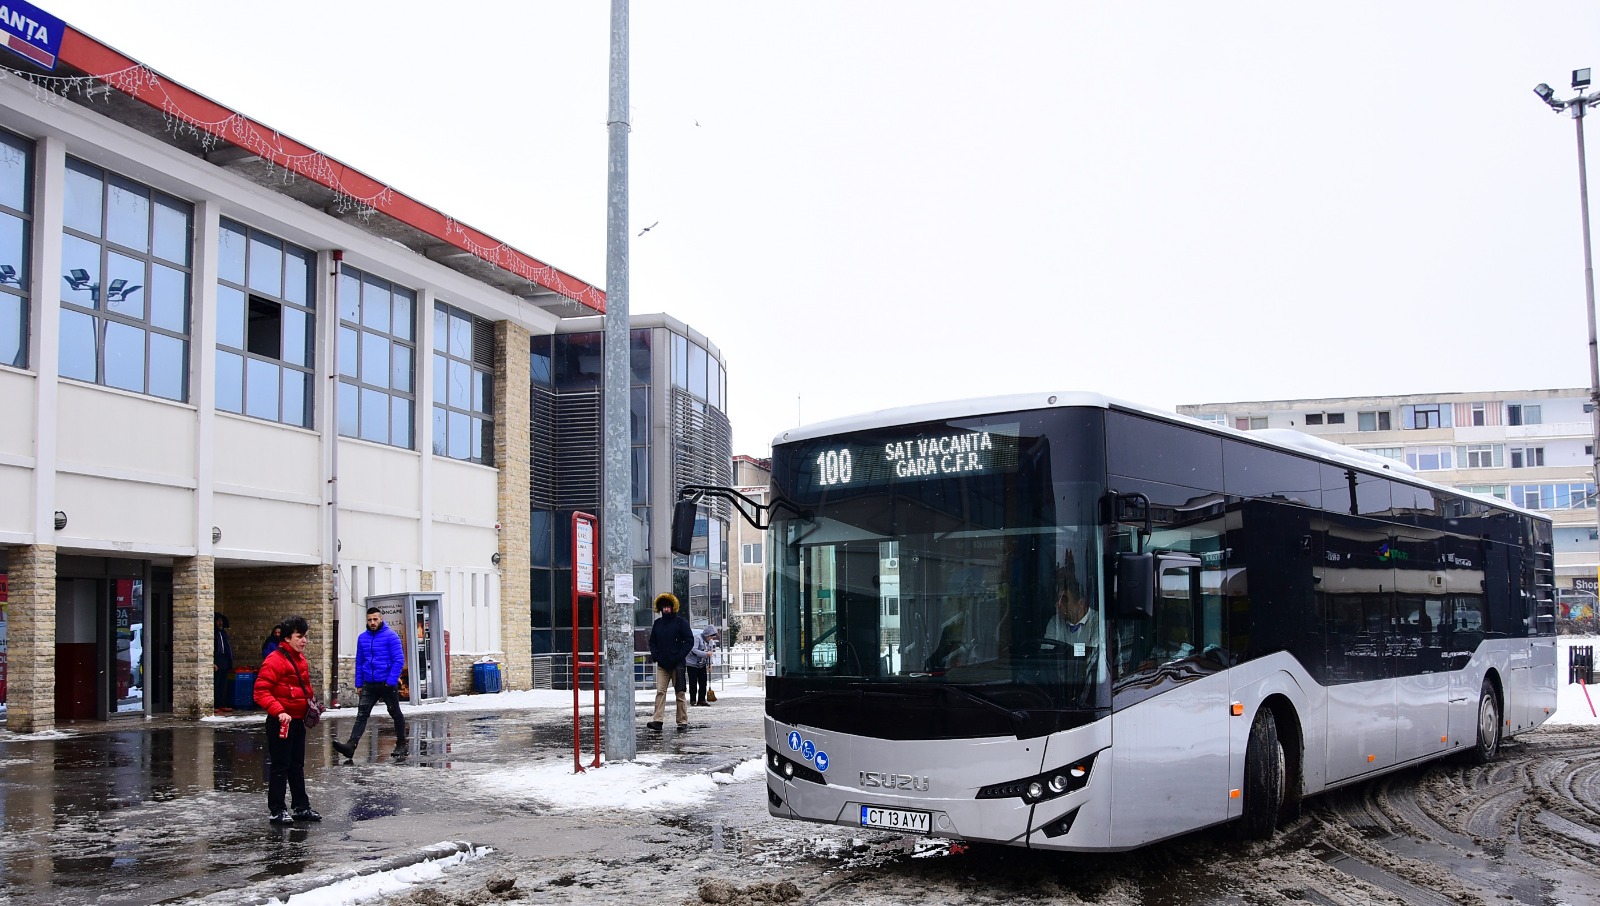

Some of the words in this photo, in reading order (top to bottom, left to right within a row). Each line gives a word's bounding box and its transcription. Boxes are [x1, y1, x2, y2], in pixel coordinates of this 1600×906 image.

[885, 441, 914, 460] SAT
[917, 431, 992, 457] VACANTA
[816, 449, 852, 485] 100
[896, 457, 937, 477] GARA
[941, 452, 983, 473] C.F.R.
[860, 771, 929, 791] ISUZU
[869, 810, 884, 824] CT
[888, 812, 899, 826] 13
[902, 813, 926, 828] AYY
